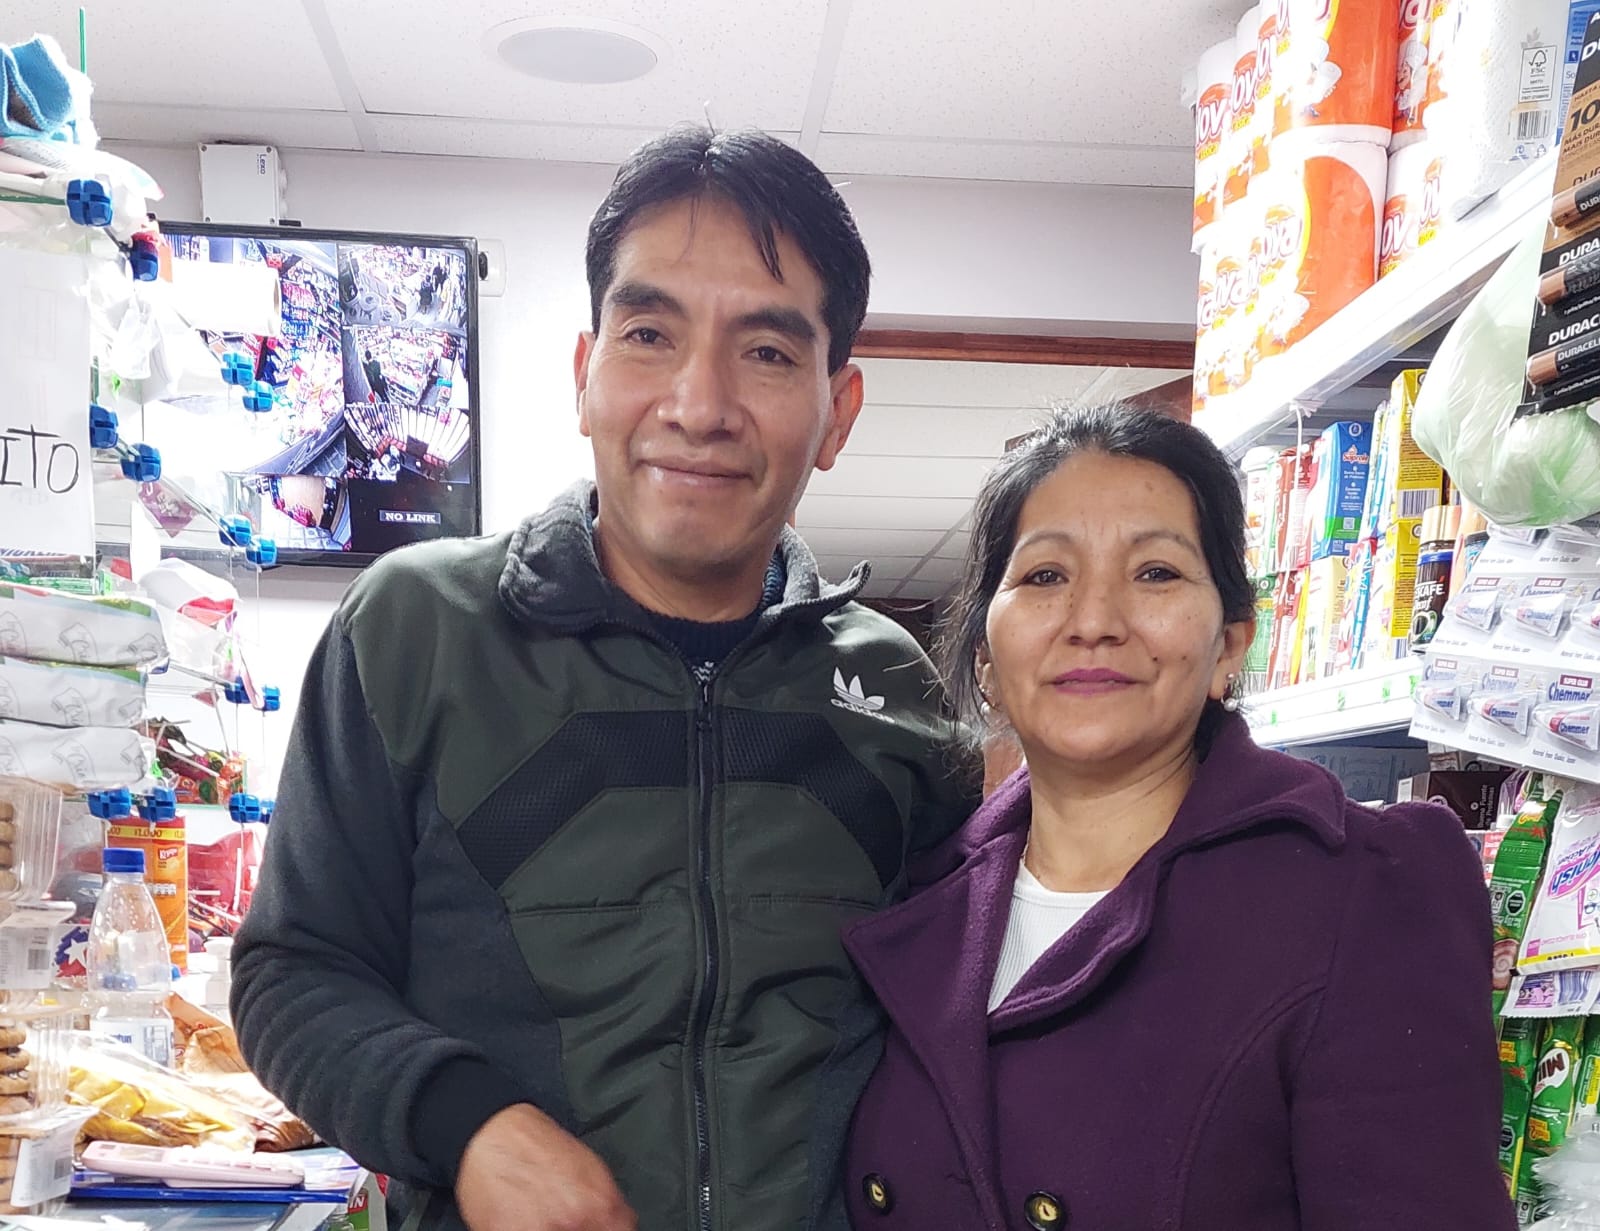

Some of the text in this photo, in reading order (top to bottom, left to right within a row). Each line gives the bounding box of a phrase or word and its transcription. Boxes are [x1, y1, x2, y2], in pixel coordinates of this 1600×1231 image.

[1583, 121, 1600, 136] DUR
[385, 512, 436, 524] NO LINK
[1548, 681, 1593, 702] Chemmer
[830, 698, 896, 724] adidas
